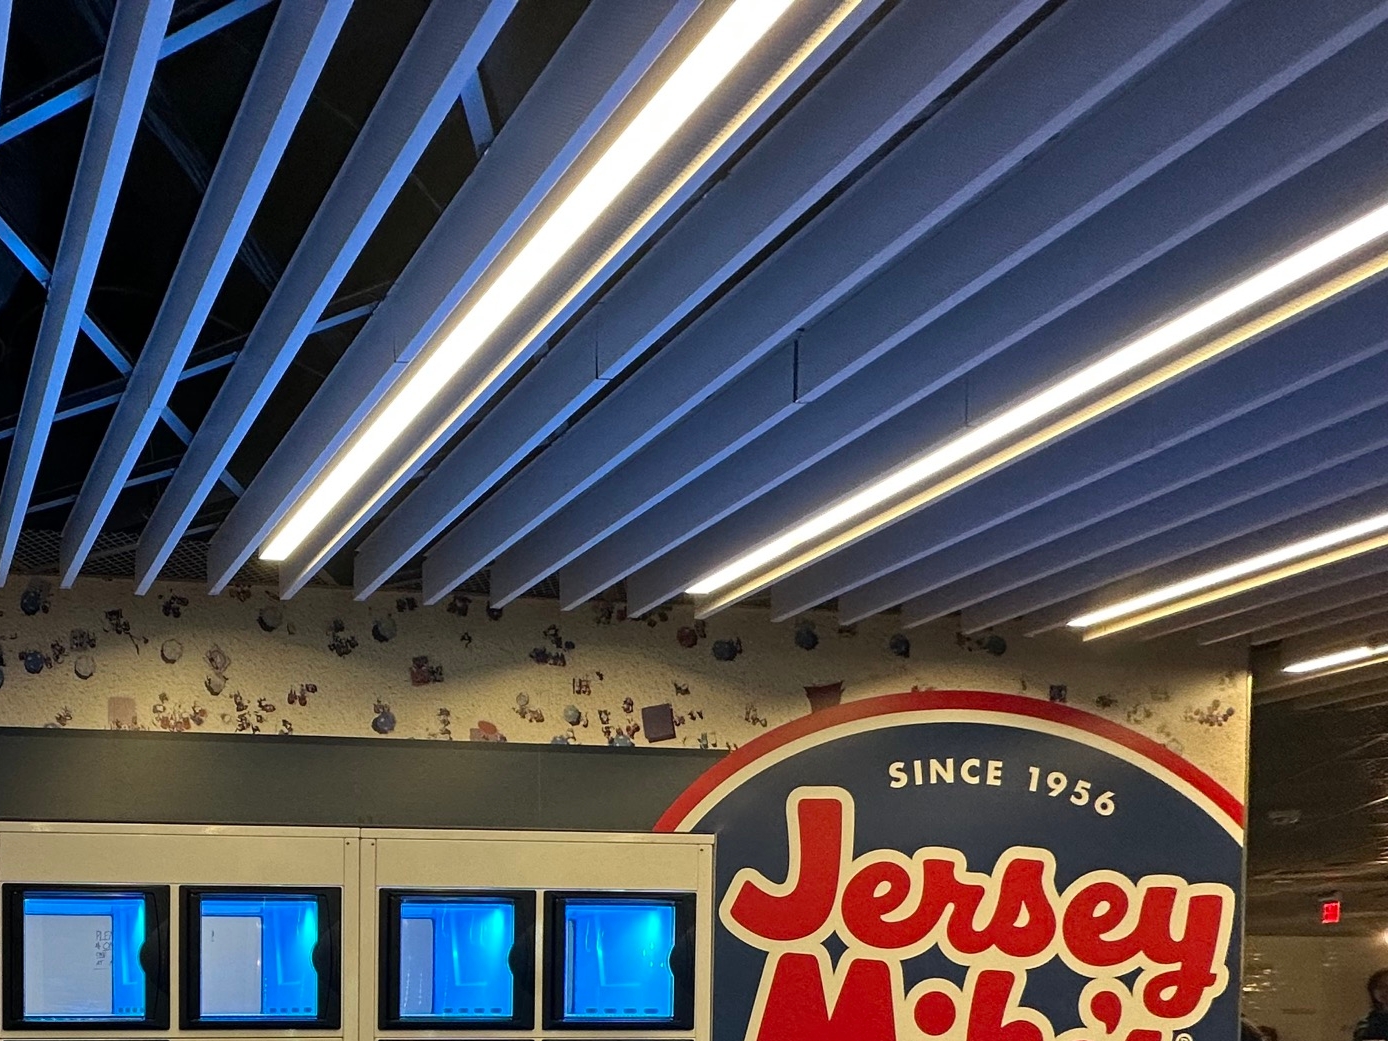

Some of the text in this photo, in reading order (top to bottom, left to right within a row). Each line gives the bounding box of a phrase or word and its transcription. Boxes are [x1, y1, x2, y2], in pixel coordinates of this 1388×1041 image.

[888, 757, 1116, 816] SINCE 1956
[727, 795, 1226, 1021] Jersey
